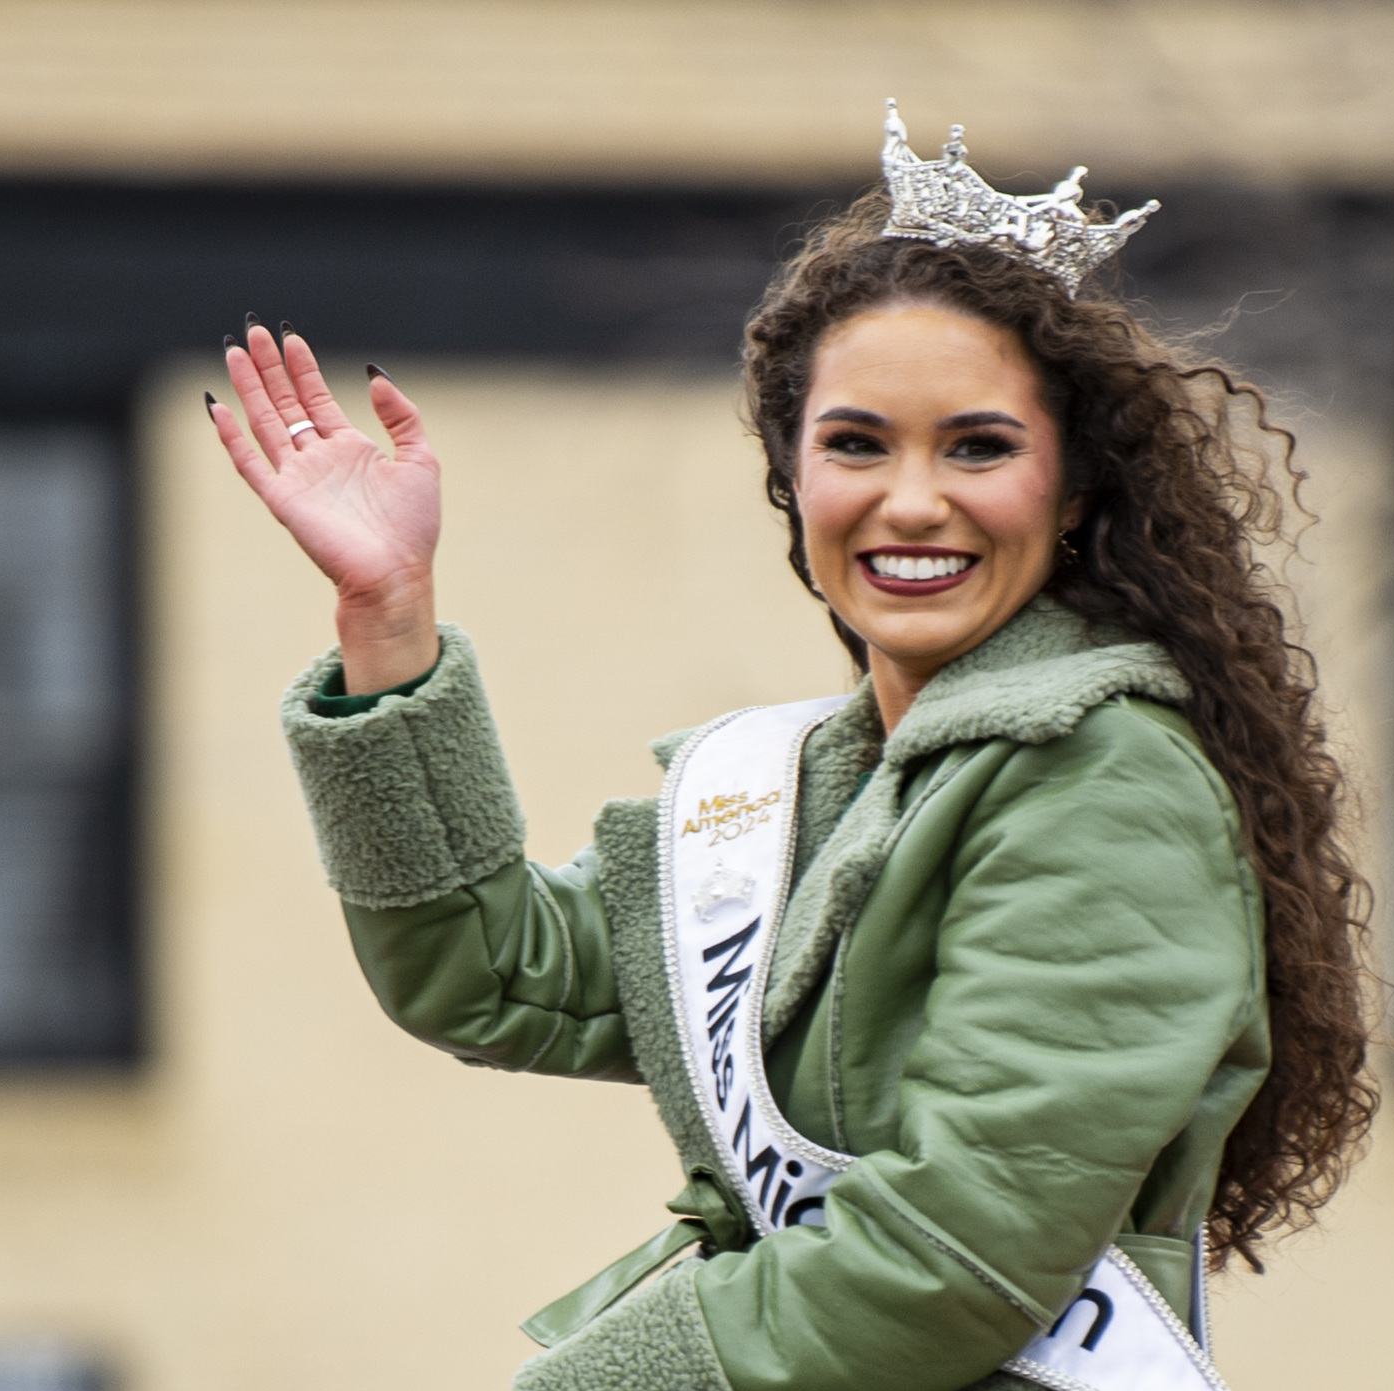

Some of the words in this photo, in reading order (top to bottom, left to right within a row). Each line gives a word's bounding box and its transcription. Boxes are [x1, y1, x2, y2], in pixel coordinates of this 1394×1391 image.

[680, 789, 781, 838] America
[698, 791, 749, 816] Miss
[708, 809, 771, 848] 2024
[703, 914, 763, 1113] Miss
